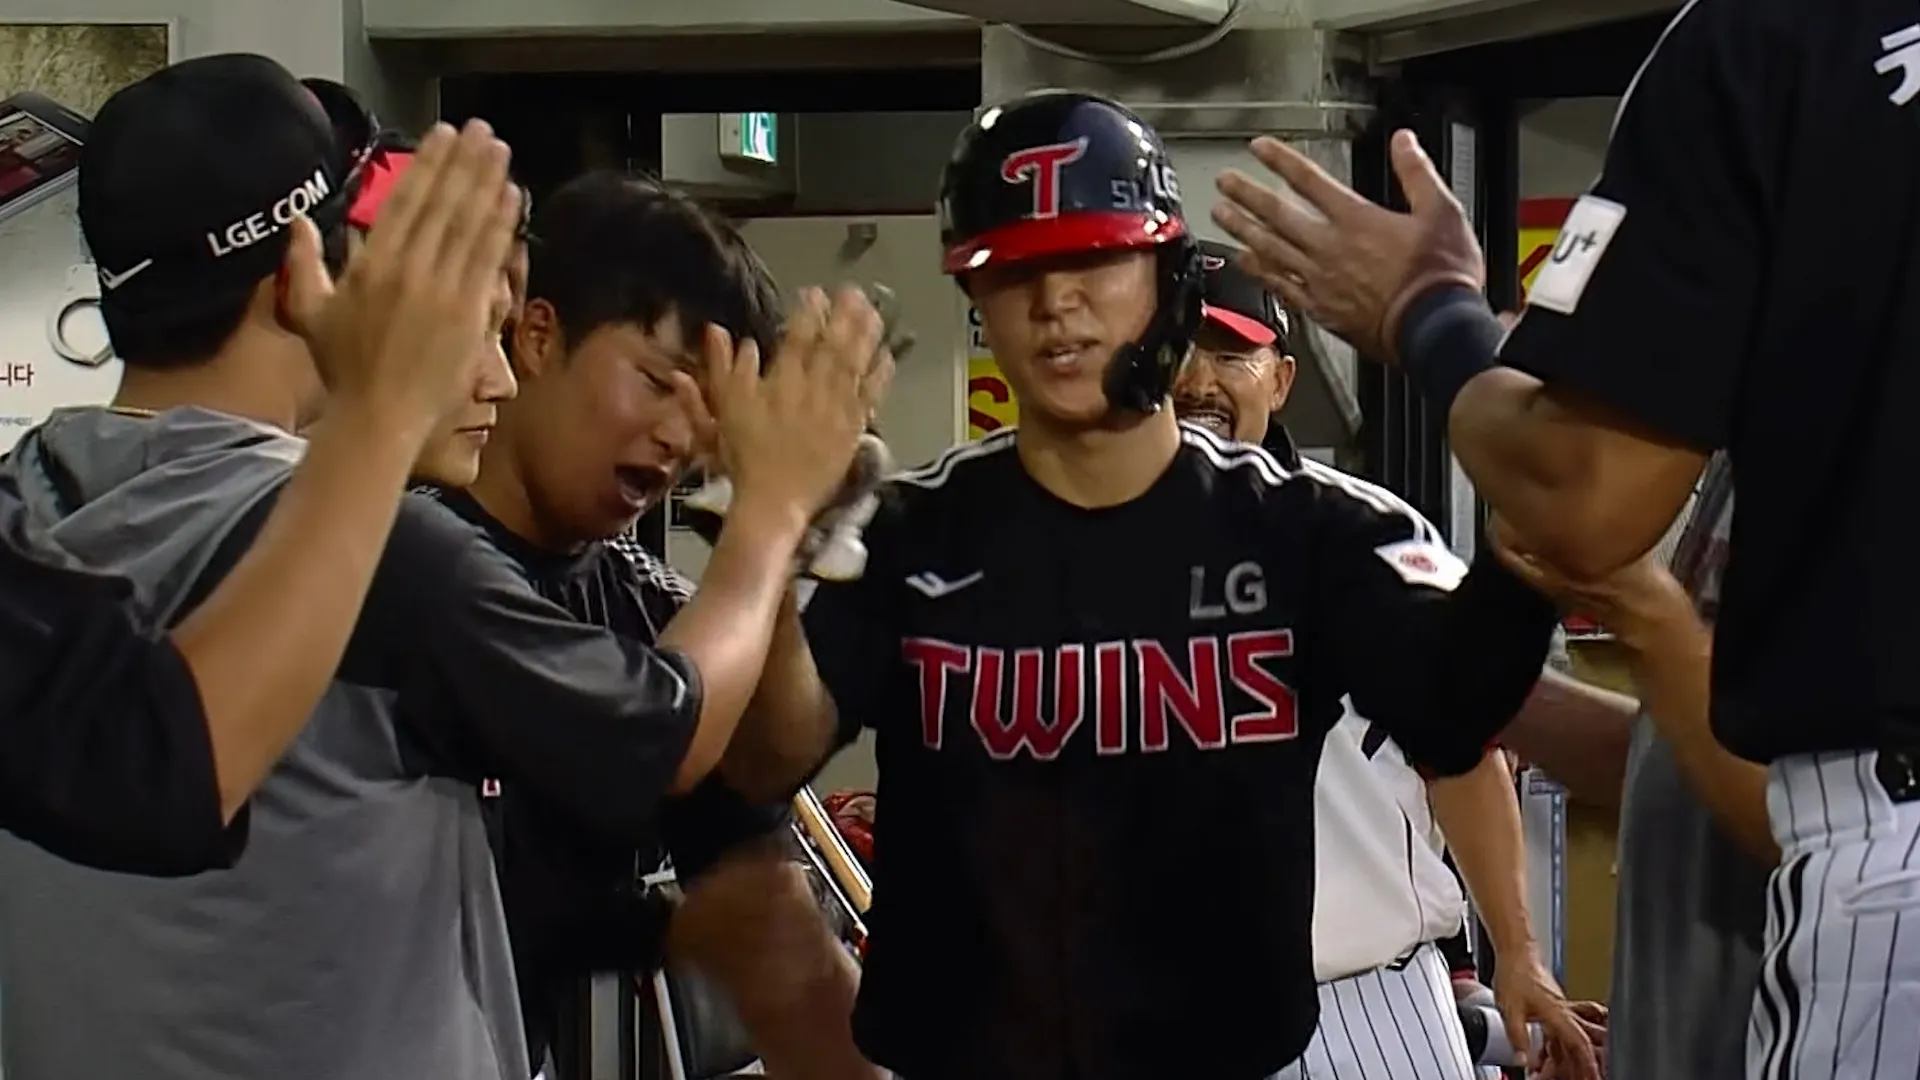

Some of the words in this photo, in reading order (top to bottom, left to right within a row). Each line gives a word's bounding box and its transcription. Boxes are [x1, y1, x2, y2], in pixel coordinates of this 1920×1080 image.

[206, 168, 330, 257] LGE.COM
[1190, 561, 1267, 619] LG
[902, 628, 1299, 760] TWINS
